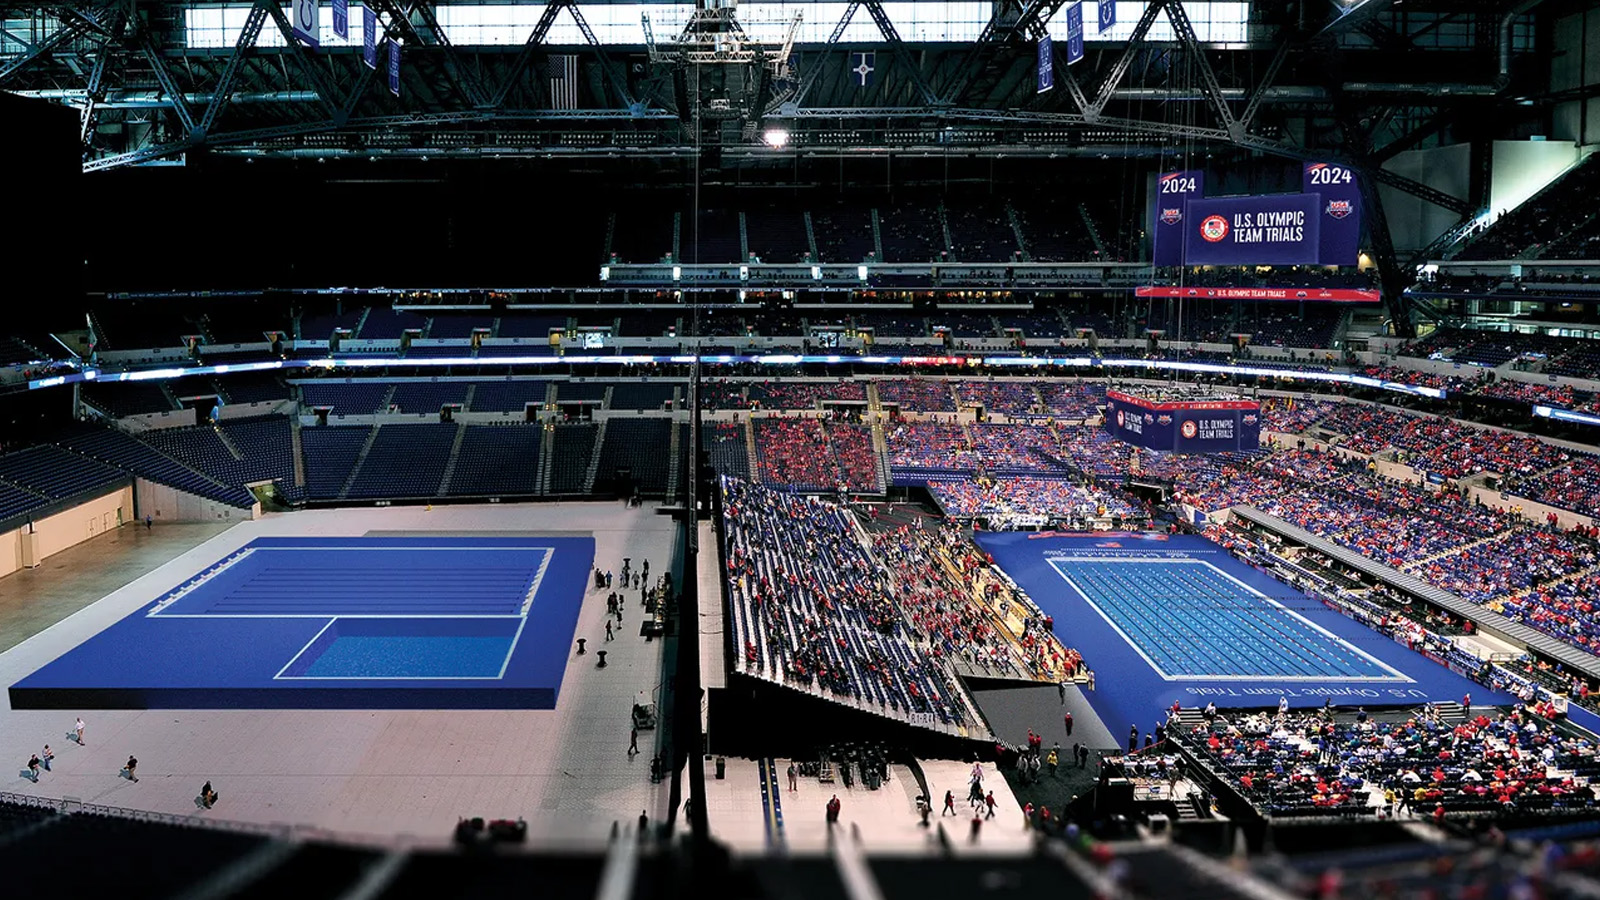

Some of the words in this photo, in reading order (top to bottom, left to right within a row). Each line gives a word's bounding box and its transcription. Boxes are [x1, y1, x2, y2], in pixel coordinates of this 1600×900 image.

[1311, 168, 1352, 184] 2024
[1162, 178, 1196, 193] 2024
[1234, 212, 1255, 228] U.S.
[1257, 210, 1304, 227] OLYMPIC
[1233, 228, 1263, 243] TEAM
[1265, 226, 1303, 242] TRIALS
[1199, 419, 1210, 430] U.S.
[1210, 419, 1234, 429] OLYMPIC
[1199, 430, 1215, 439] TEAM
[1215, 430, 1234, 439] TRIALS
[1186, 688, 1242, 696] Trials
[1242, 688, 1301, 697] Team
[1301, 687, 1380, 698] Olympic
